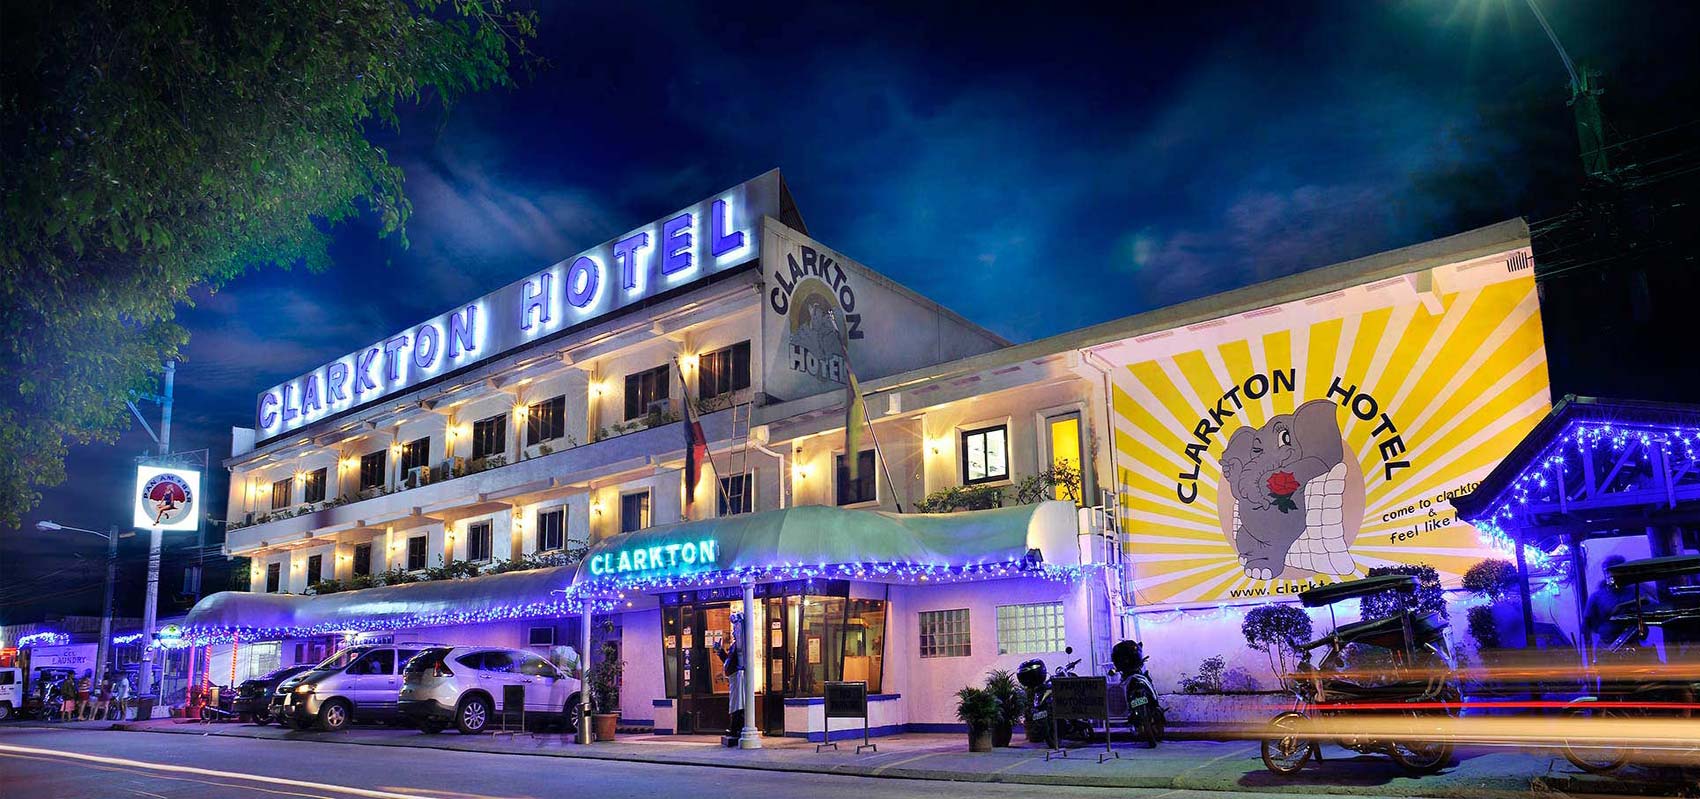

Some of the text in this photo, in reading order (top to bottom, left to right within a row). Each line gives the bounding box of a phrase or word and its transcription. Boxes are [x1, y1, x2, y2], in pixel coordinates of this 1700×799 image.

[771, 245, 864, 340] CLARKTON
[259, 199, 744, 428] CLARKTON HOTEL
[789, 343, 848, 385] HOTEL
[1177, 368, 1411, 504] CLARKTON HOTEL
[143, 479, 157, 499] PAN
[1382, 480, 1483, 522] come to clarkto
[1390, 517, 1450, 544] feel like
[1428, 508, 1437, 517] &
[591, 539, 716, 576] CLARKTON
[52, 656, 87, 665] LAUNDRY
